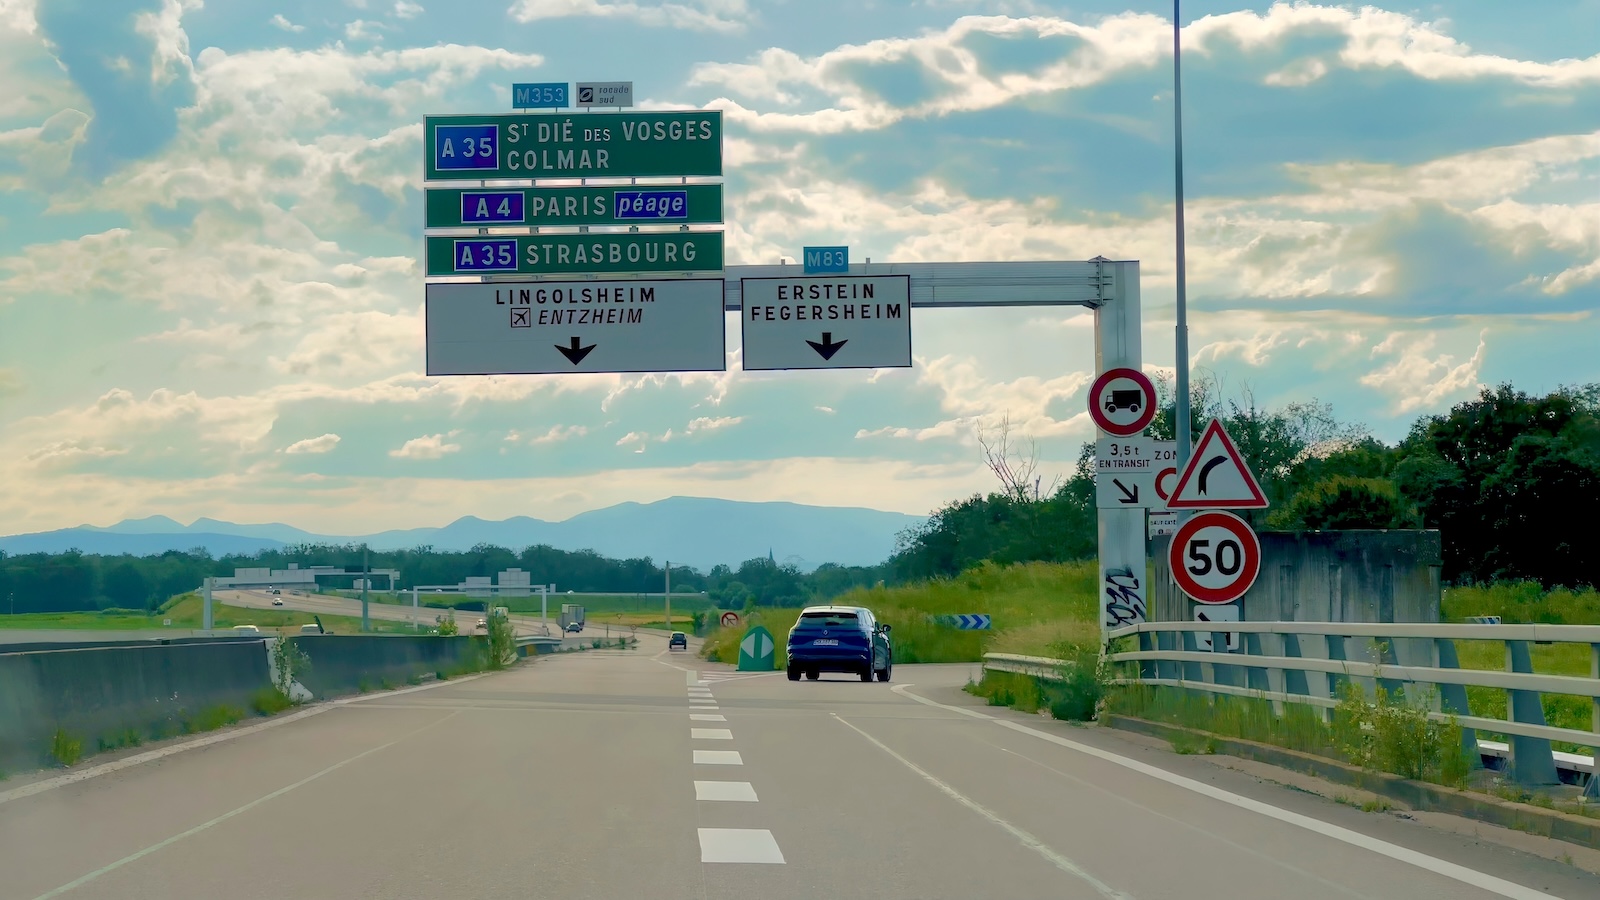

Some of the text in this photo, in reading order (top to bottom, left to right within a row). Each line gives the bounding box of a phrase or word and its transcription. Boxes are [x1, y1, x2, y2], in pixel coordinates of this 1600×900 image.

[516, 87, 565, 104] M353
[599, 85, 629, 94] rocade
[599, 95, 615, 104] sud
[507, 118, 712, 143] ST DIÉ DES VOSGES
[442, 137, 493, 158] A 35
[507, 149, 609, 171] COLMAR
[476, 198, 511, 218] A 4
[532, 196, 606, 217] PARIS
[618, 192, 684, 218] péage
[460, 244, 511, 266] A 35
[526, 242, 696, 265] STRASBOURG
[807, 251, 844, 267] M83
[496, 287, 655, 305] LINGOLSHEIM
[778, 283, 874, 300] ERSTEIN
[538, 308, 643, 325] ENTZHEIM
[751, 303, 901, 321] FEGERSHEIM
[1110, 443, 1140, 457] 3,5 t
[1099, 459, 1150, 468] EN TRANSIT
[1188, 539, 1241, 576] 50
